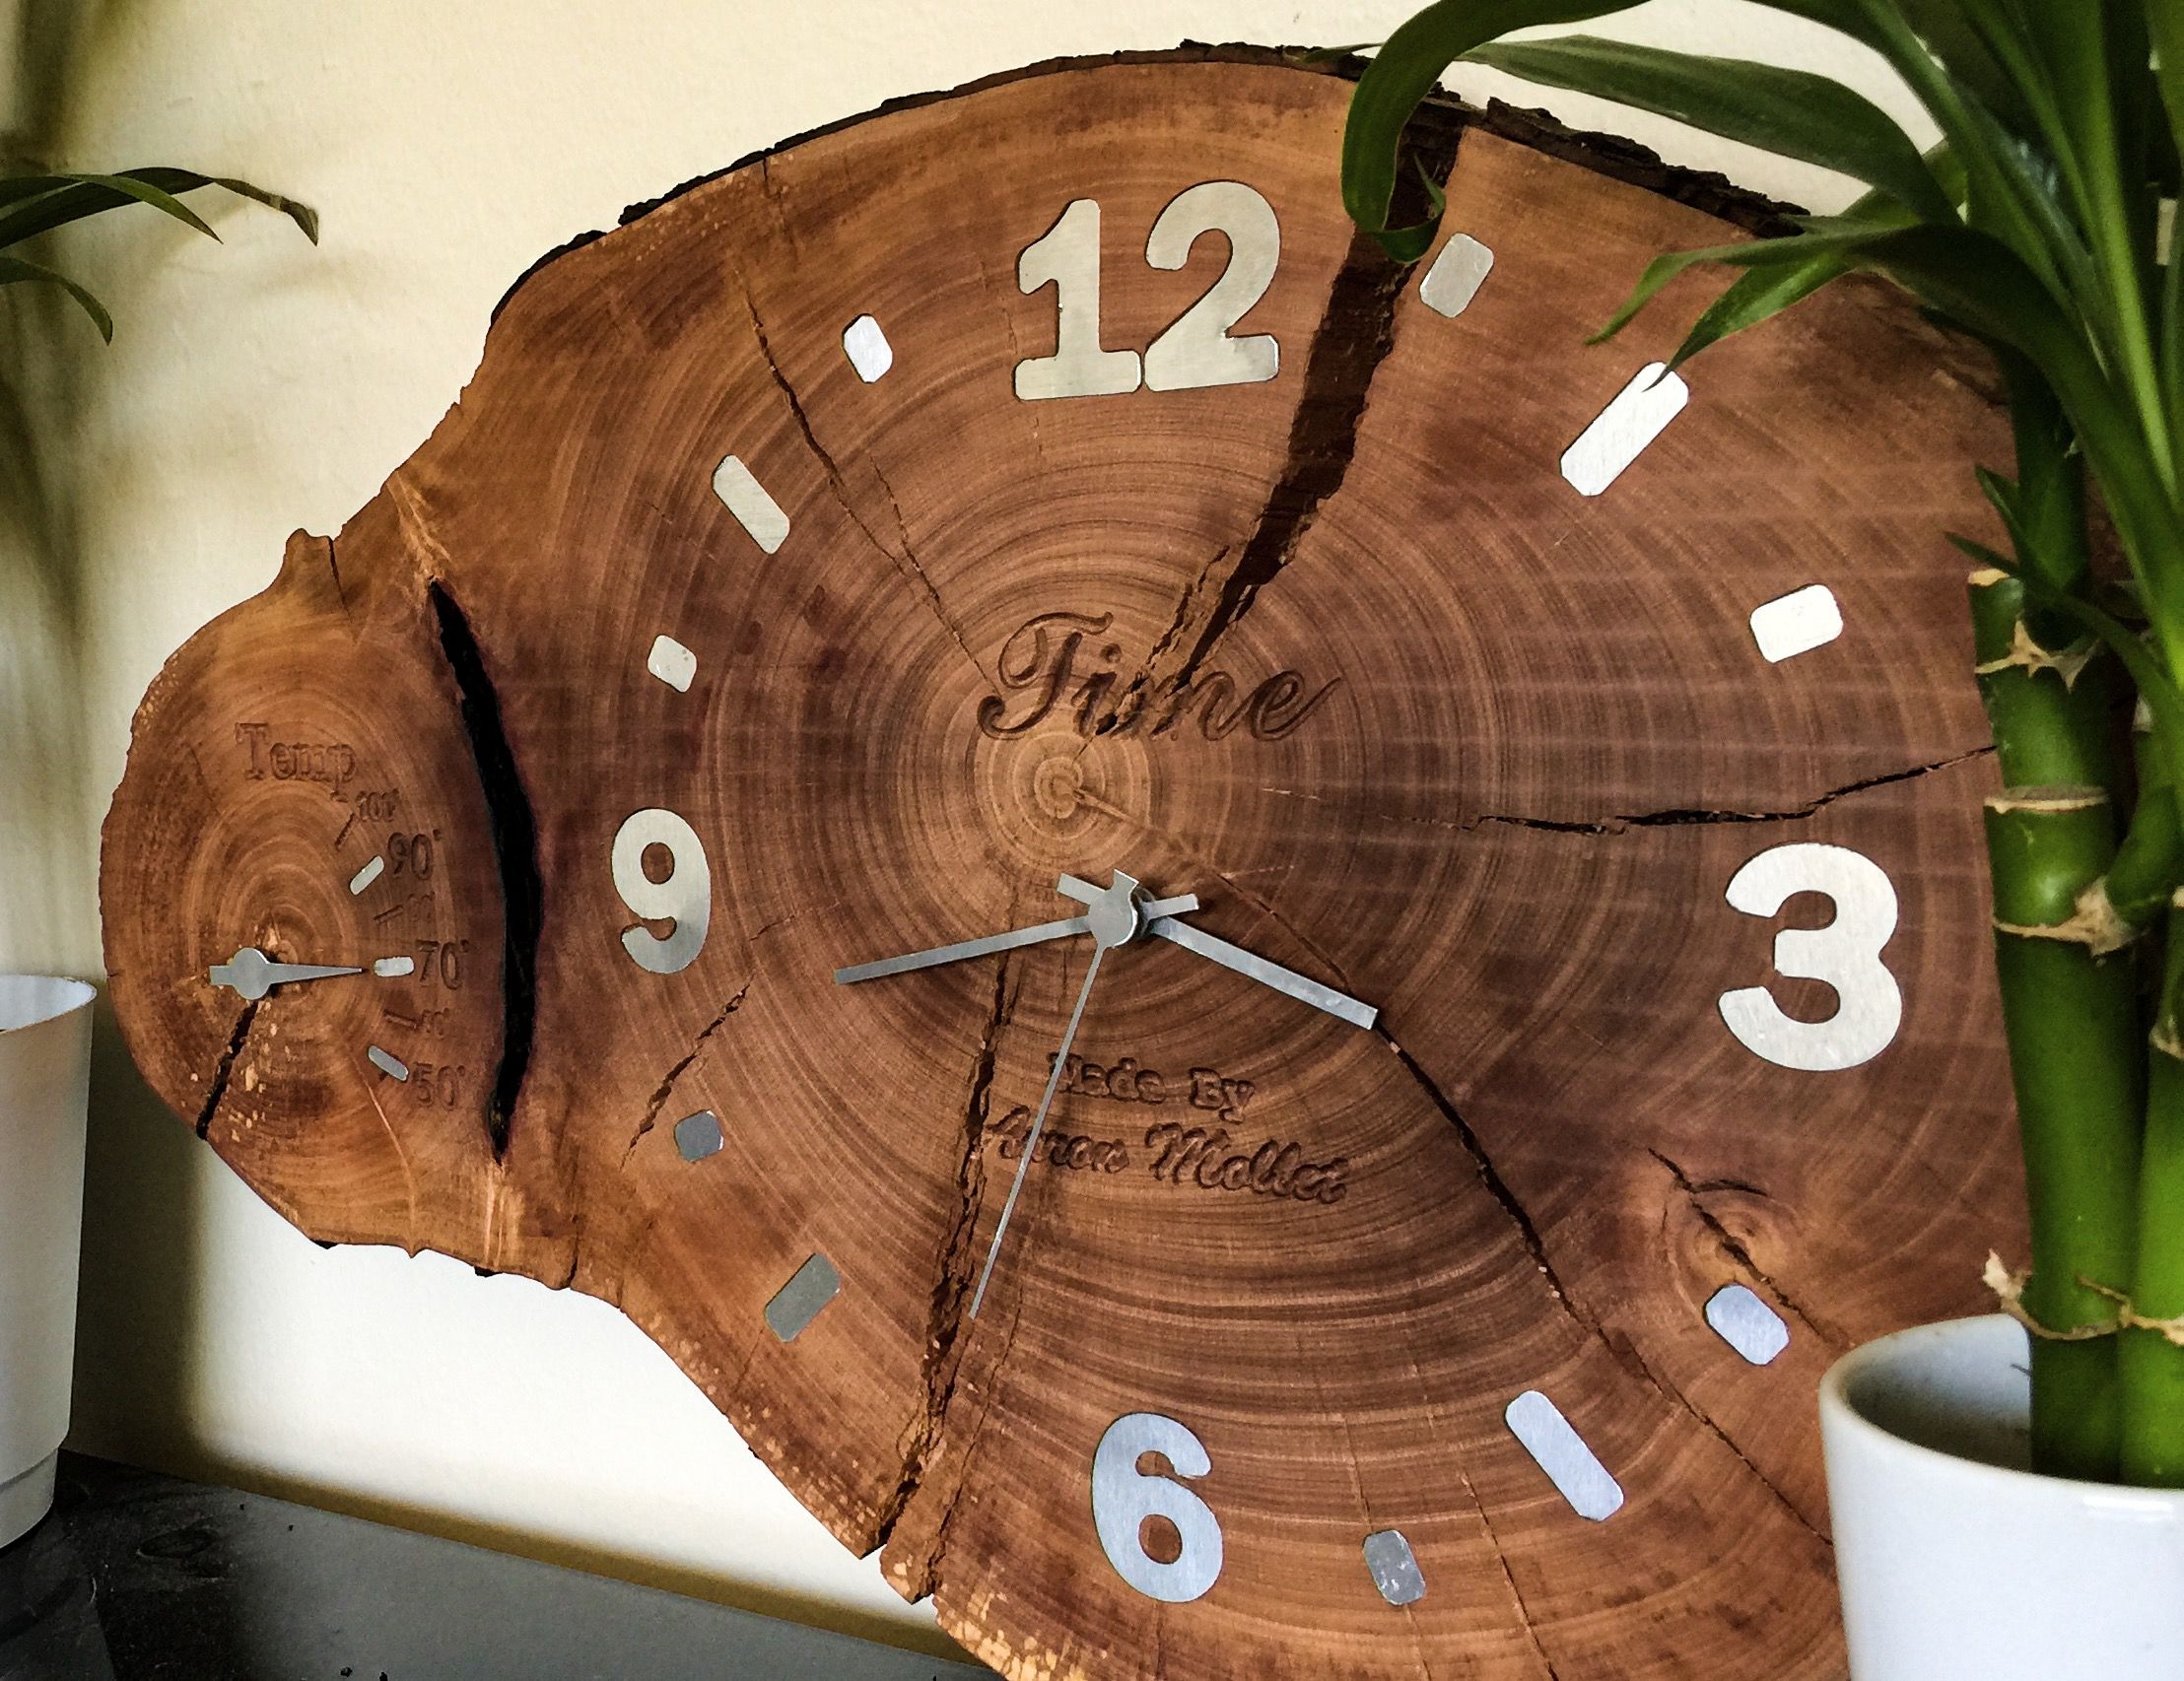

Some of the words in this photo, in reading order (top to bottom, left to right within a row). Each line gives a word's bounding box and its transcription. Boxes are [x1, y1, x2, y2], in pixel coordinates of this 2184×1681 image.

[1014, 179, 1281, 401] 12
[977, 611, 1342, 741] Time
[233, 722, 358, 802] Temp
[611, 807, 712, 975] 9
[1718, 842, 1902, 1071] 3
[1189, 1067, 1257, 1125] By
[1091, 1412, 1223, 1602] 6
